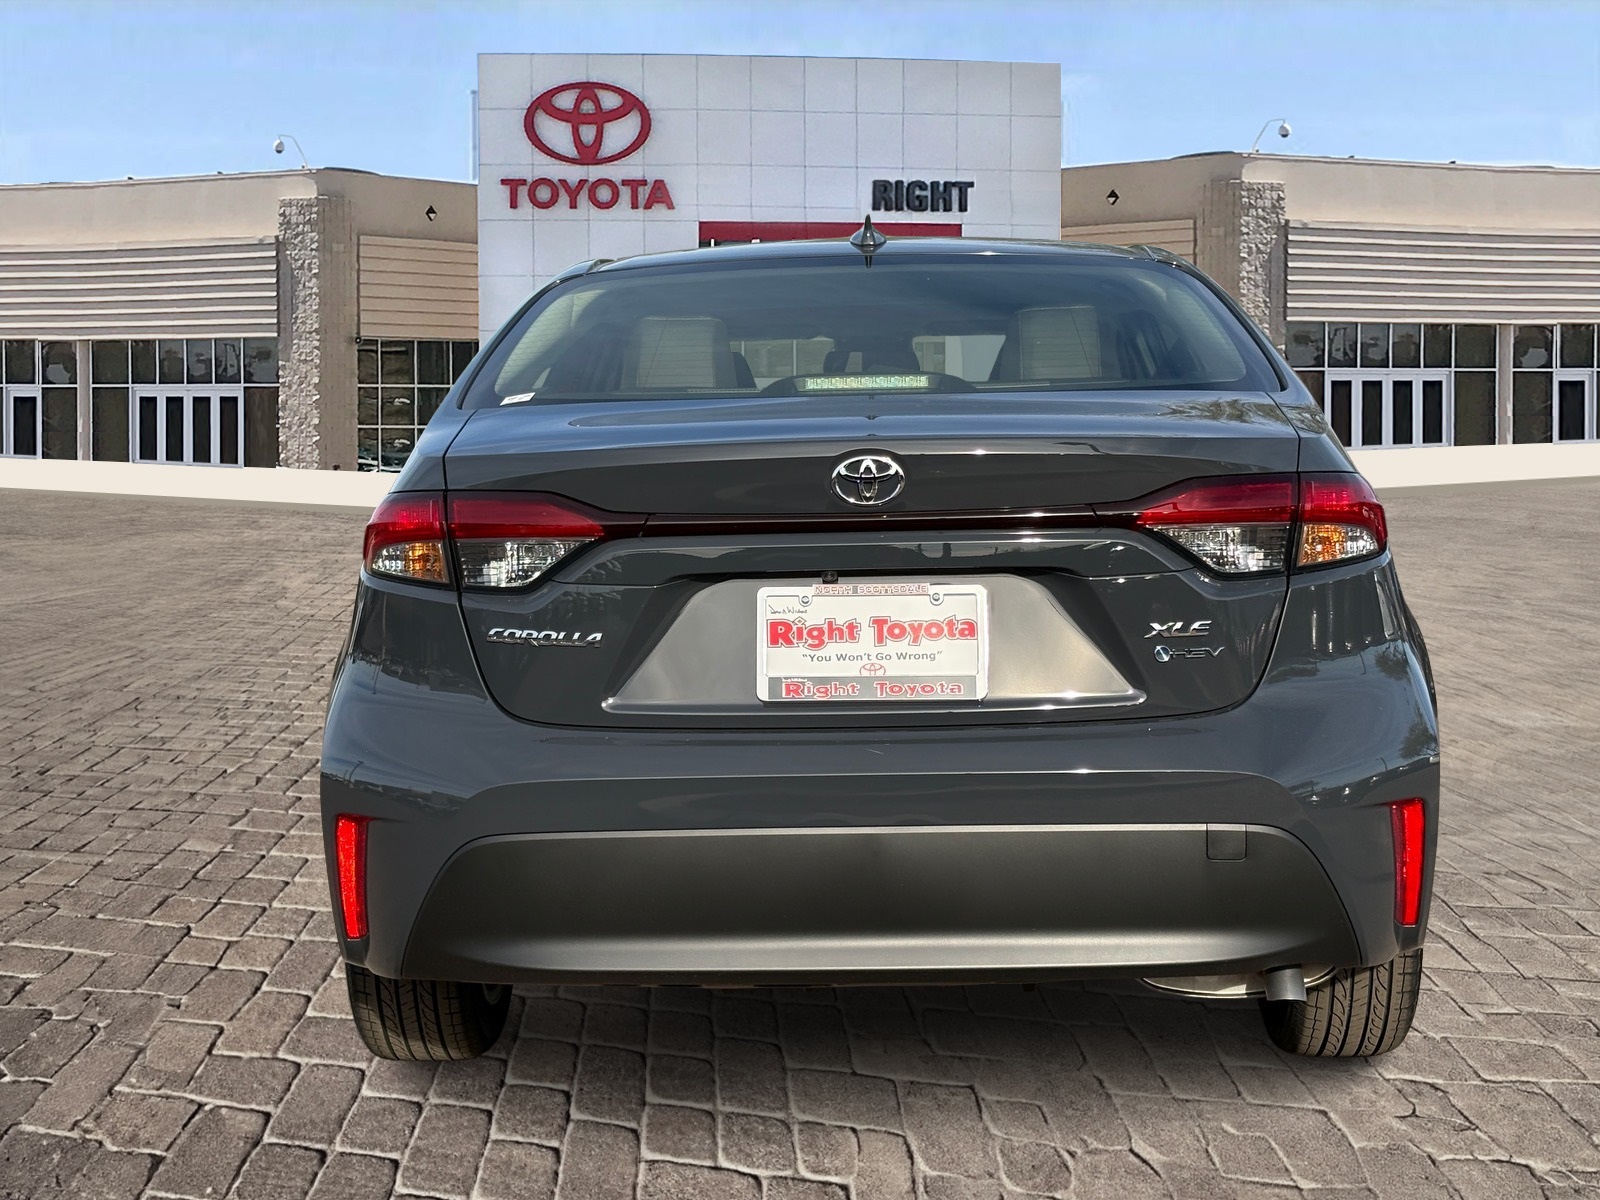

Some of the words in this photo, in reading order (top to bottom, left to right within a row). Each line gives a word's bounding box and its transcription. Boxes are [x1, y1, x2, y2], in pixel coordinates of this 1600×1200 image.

[501, 179, 676, 210] TOYOTA
[871, 180, 975, 212] RIGHT
[487, 628, 603, 648] COROLLA
[767, 618, 861, 650] Right
[869, 615, 978, 647] Toyota
[1144, 621, 1212, 638] XLE
[875, 652, 892, 661] Go
[782, 682, 860, 699] Right
[873, 681, 964, 699] Toyota
